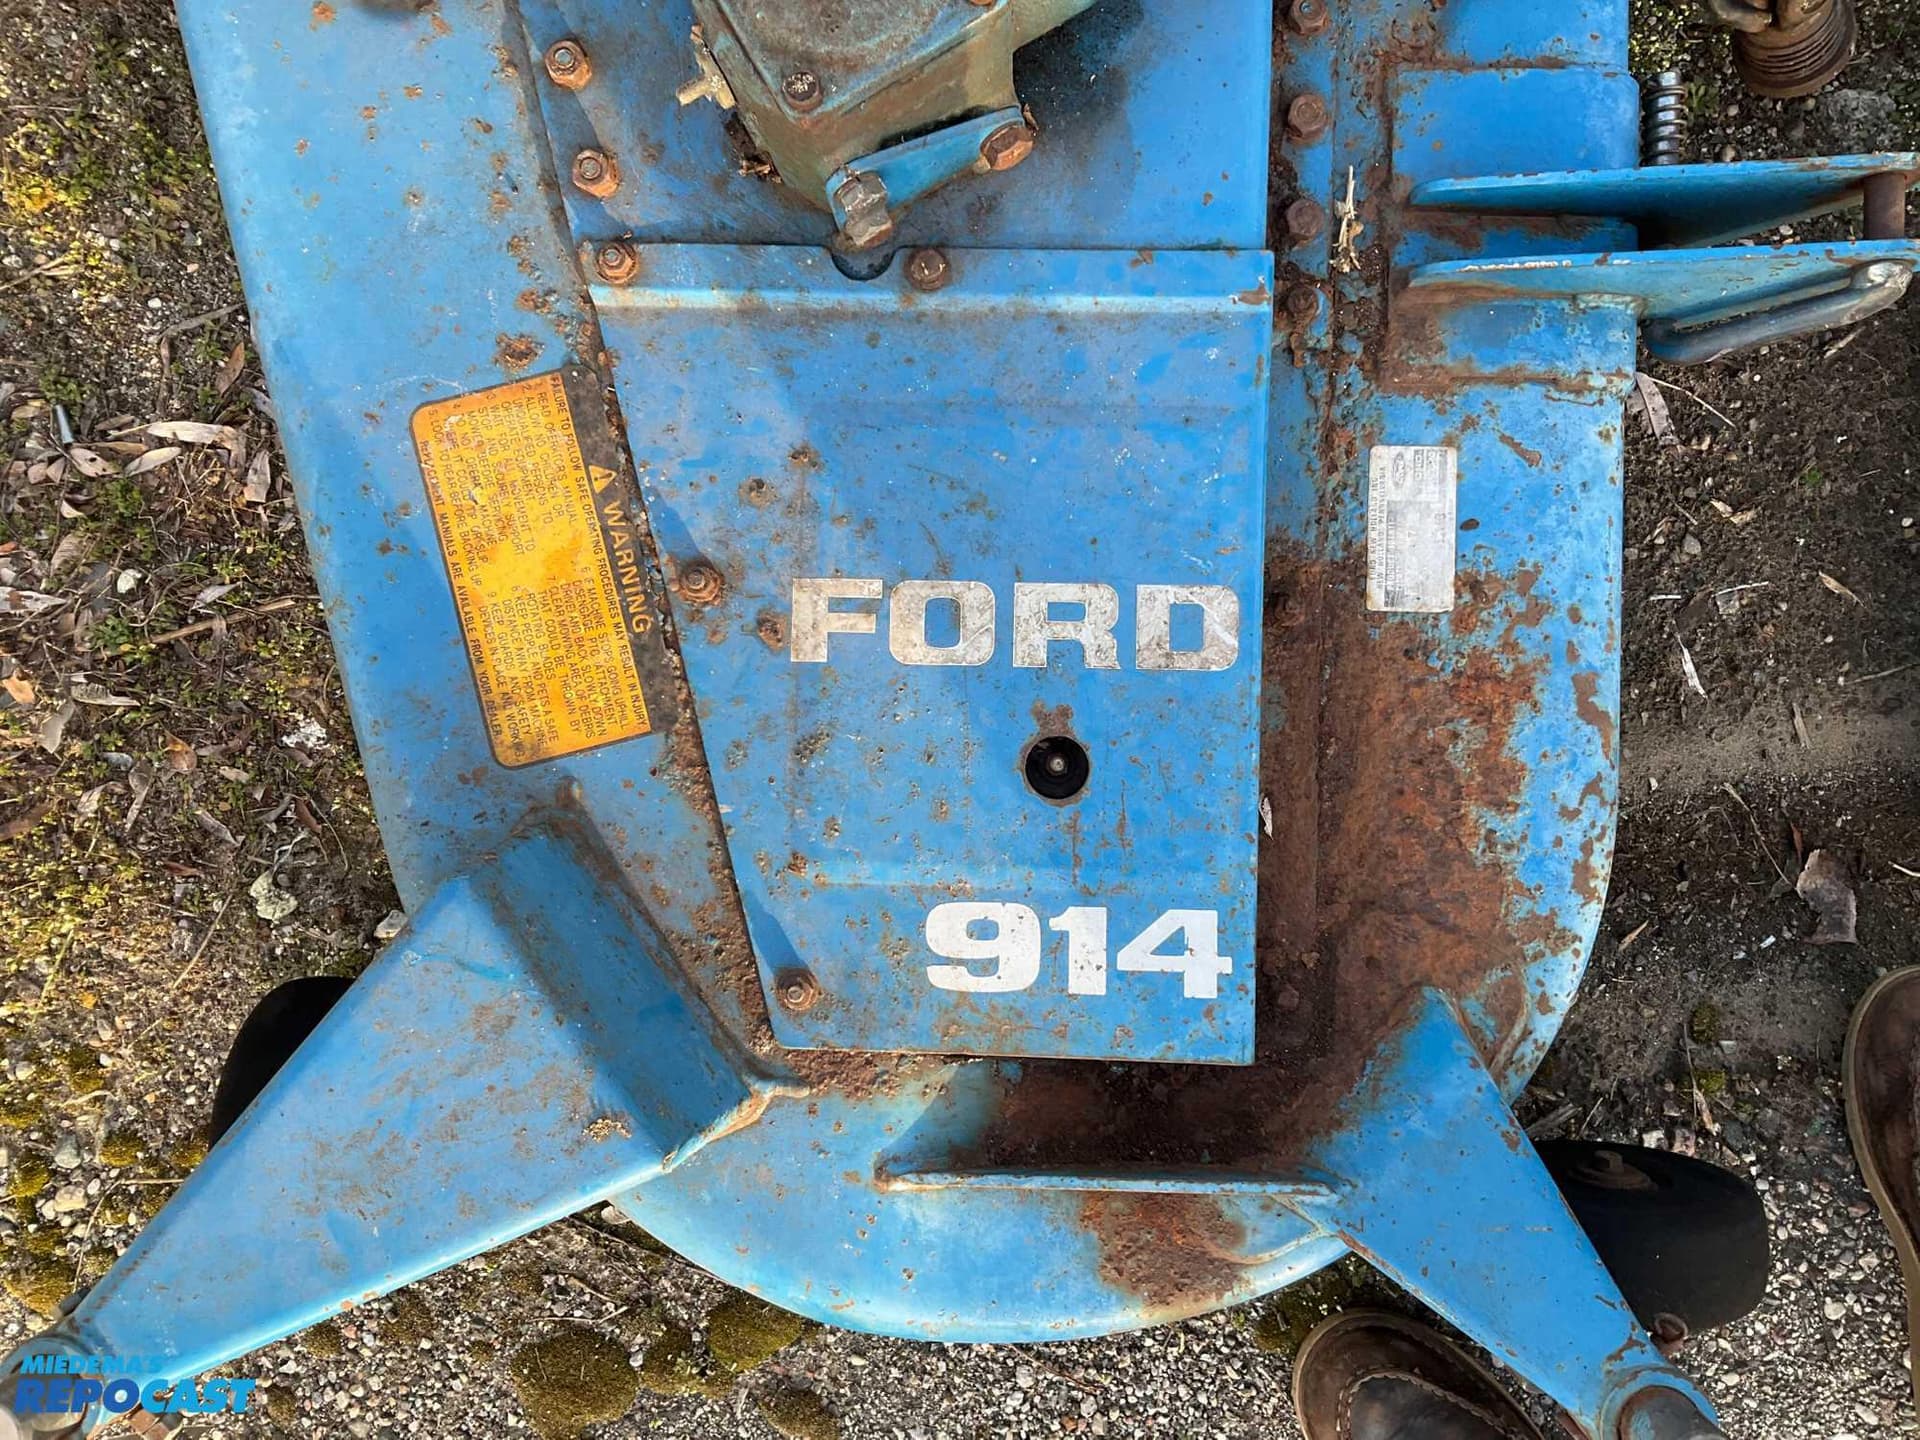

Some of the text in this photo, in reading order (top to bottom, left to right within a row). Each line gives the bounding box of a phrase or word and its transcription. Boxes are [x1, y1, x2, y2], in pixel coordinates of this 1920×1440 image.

[524, 395, 541, 428] ALLOW
[535, 391, 552, 418] READ
[547, 375, 567, 415] FAILURE
[488, 404, 504, 427] WAIT
[500, 400, 520, 445] OPERATE
[558, 417, 571, 431] TO
[430, 419, 445, 446] LOOK
[496, 431, 510, 452] FOR
[533, 432, 546, 447] NO
[437, 448, 449, 461] TO
[465, 410, 484, 448] MOWER
[476, 450, 494, 489] BEFORE
[502, 456, 515, 473] ALL
[511, 397, 553, 524] UNQUALIFIED PERSONS TO
[562, 432, 582, 472] FOLLOW
[441, 463, 457, 490] REAR
[455, 468, 472, 501] COULD
[477, 406, 524, 555] STOP AND SECURELY SUPPORT
[538, 451, 560, 499] CHILDREN
[573, 475, 589, 502] SAFE
[448, 490, 467, 529] BEFORE
[464, 504, 477, 520] TIP
[508, 478, 531, 532] MOVEMENT
[552, 502, 565, 518] OR
[436, 512, 457, 557] MANUALS
[469, 524, 482, 540] OR
[477, 503, 497, 546] MACHINE
[581, 502, 603, 555] OPERATING
[458, 530, 478, 572] BACKING
[474, 543, 489, 564] SLIP
[523, 538, 536, 552] TO
[449, 560, 463, 580] ARE
[600, 499, 654, 634] WARNING
[547, 585, 565, 617] CLEAR
[595, 557, 620, 619] PROCEDURES
[455, 583, 477, 634] AVAILABLE
[489, 601, 504, 627] KEEP
[500, 598, 522, 644] DISTANCE
[512, 595, 529, 620] KEEP
[524, 592, 546, 640] ROTATING
[571, 579, 594, 633] DISENGAGE
[586, 636, 600, 657] PTO
[585, 587, 606, 630] MACHINE
[519, 621, 539, 660] PEOPLE
[556, 618, 576, 660] MOWING
[567, 614, 582, 635] AND
[611, 621, 626, 642] MAY
[791, 578, 1240, 672] FORD
[469, 637, 485, 665] FROM
[476, 604, 496, 645] DEVICES
[490, 656, 508, 689] PLACE
[499, 690, 513, 710] AND
[496, 630, 516, 671] GUARDS
[513, 645, 529, 673] AWAY
[536, 589, 583, 733] THAT COULD BE THROWN BY
[573, 635, 589, 662] BACK
[597, 631, 615, 664] STOPS
[617, 643, 636, 679] RESULT
[477, 669, 493, 695] YOUR
[507, 674, 522, 695] AND
[529, 660, 544, 681] AND
[567, 661, 583, 688] AREA
[580, 663, 600, 704] SLOWLY
[606, 664, 623, 696] GOING
[520, 674, 537, 702] FROM
[535, 681, 551, 707] PETS
[574, 687, 587, 702] OF
[514, 699, 533, 736] SAFETY
[544, 716, 560, 743] SAFE
[578, 703, 597, 739] DEBRIS
[591, 705, 608, 737] DOWN
[614, 696, 632, 730] UPHILL
[925, 901, 1233, 1000] 914
